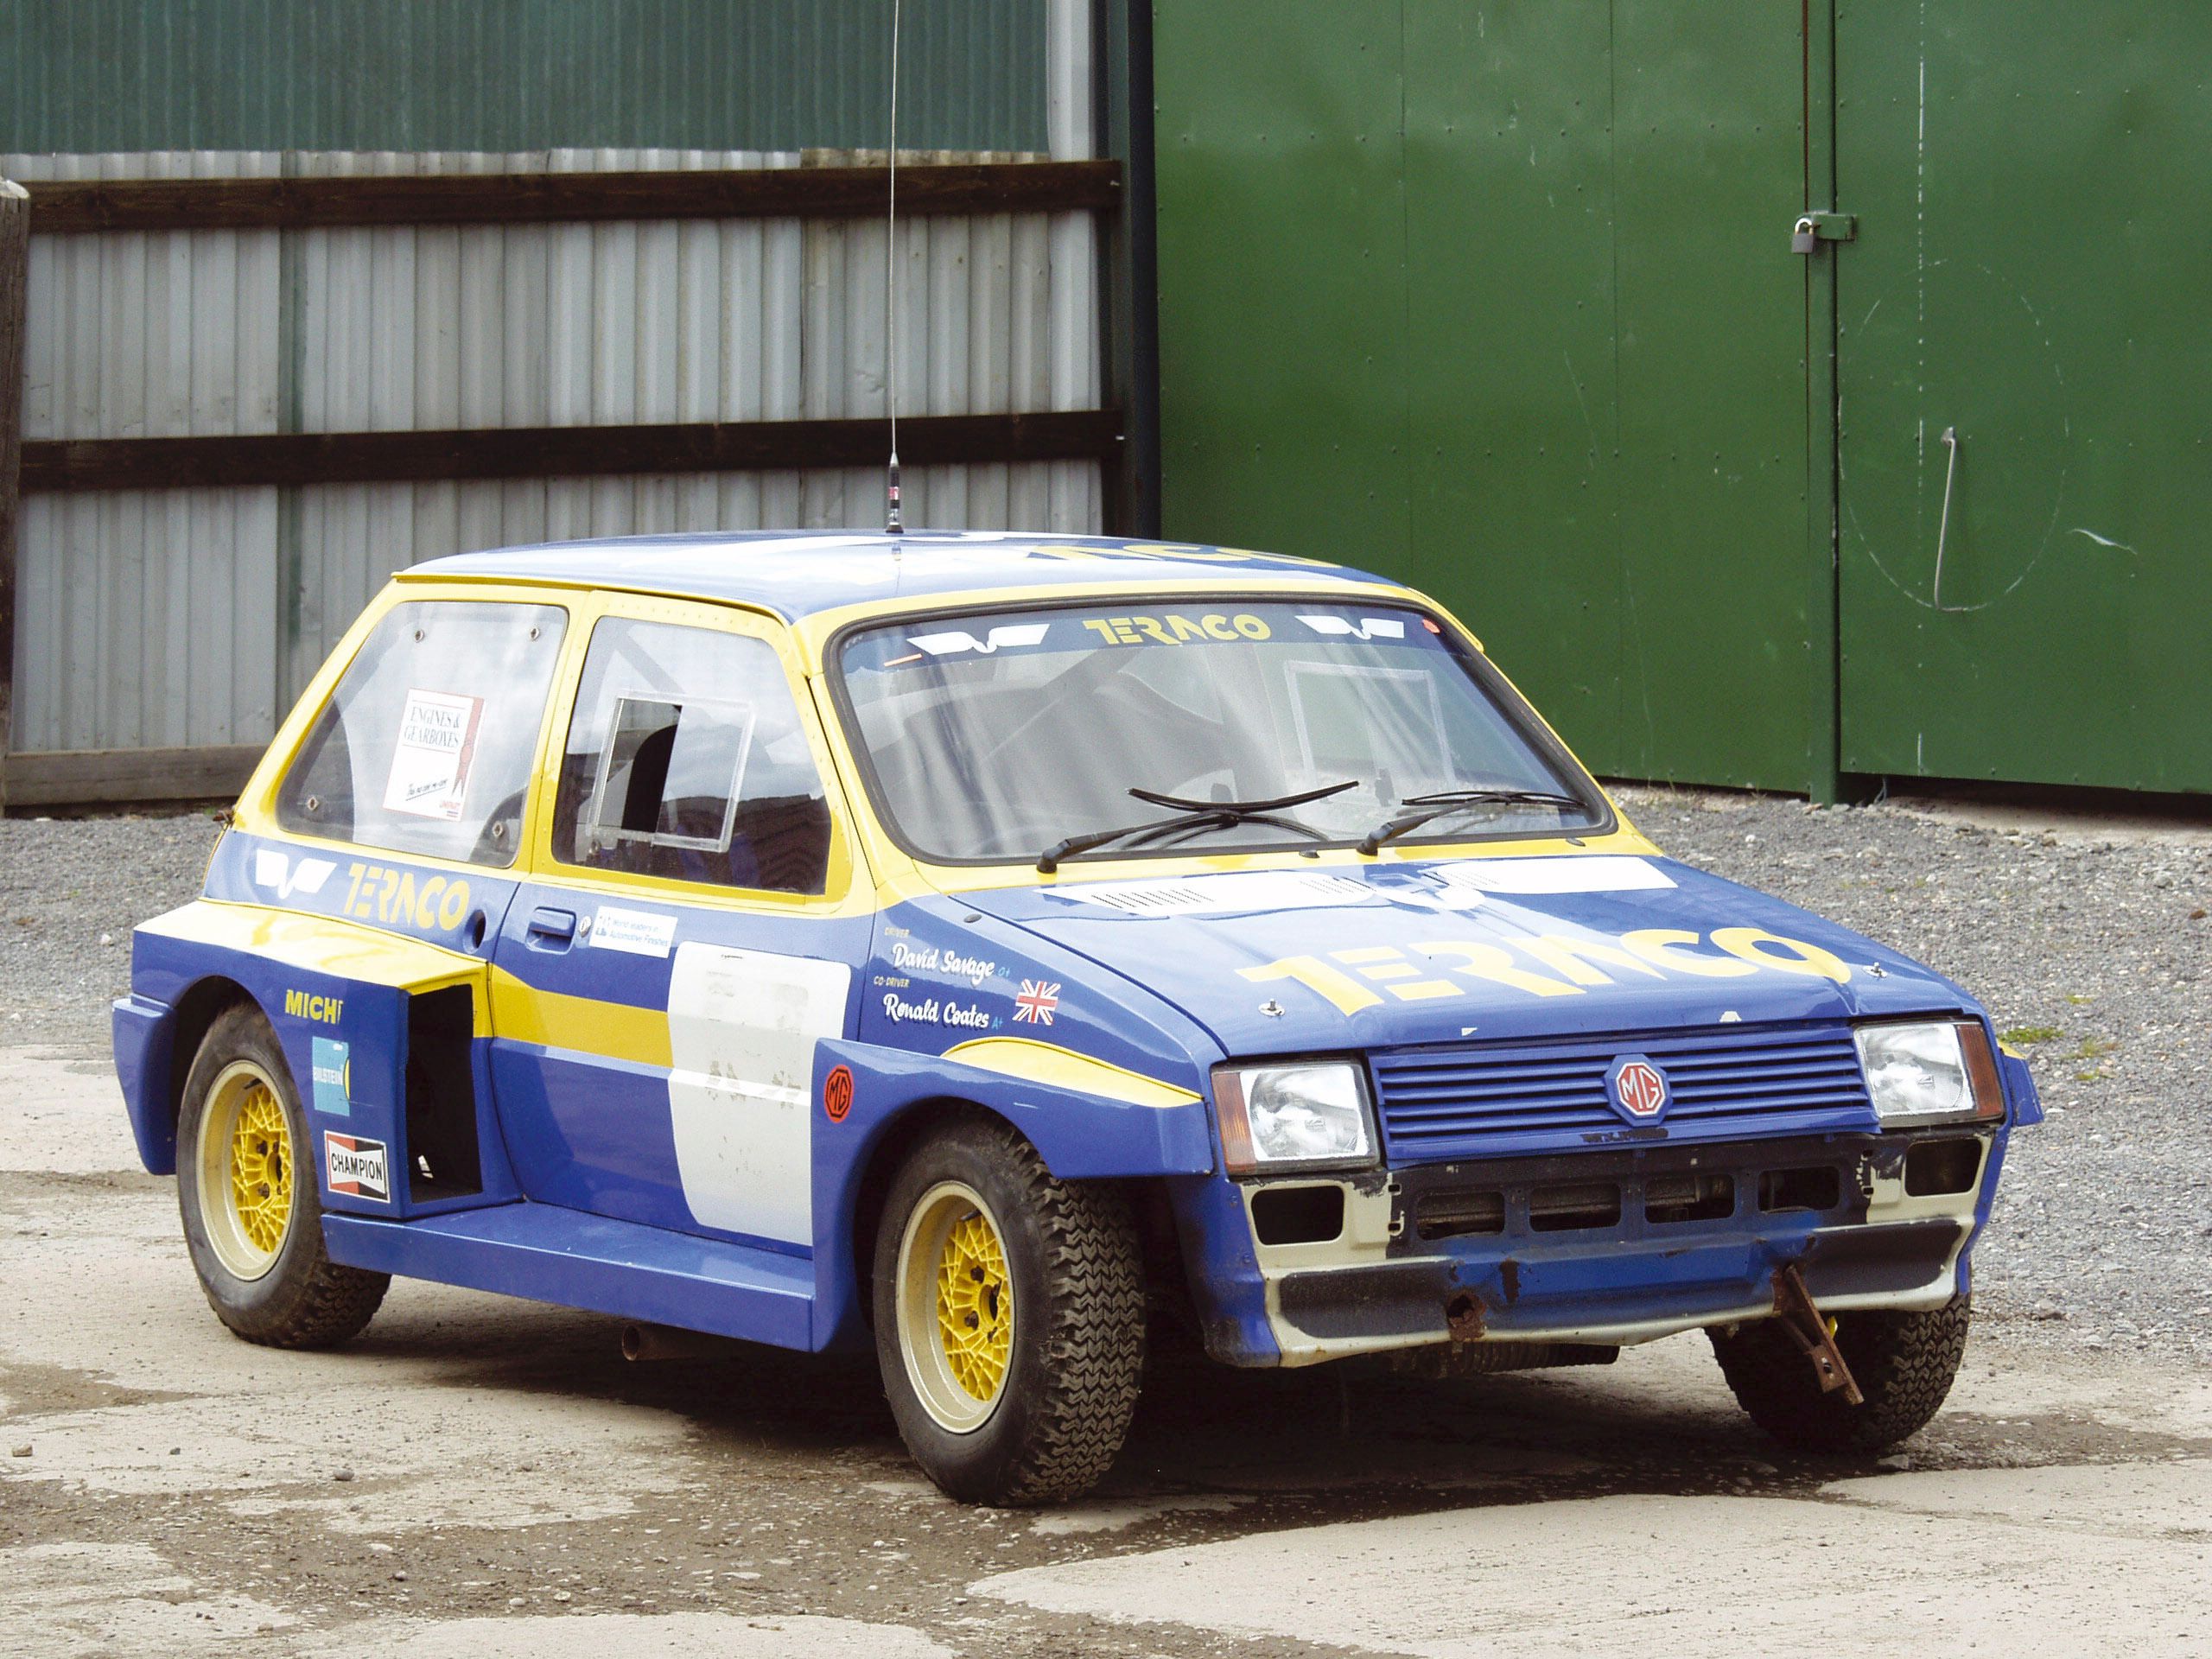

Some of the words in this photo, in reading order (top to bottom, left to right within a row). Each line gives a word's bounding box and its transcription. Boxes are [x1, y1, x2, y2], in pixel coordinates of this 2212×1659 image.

[1082, 613, 1272, 645] TERACO
[410, 706, 452, 728] ENGINES
[404, 725, 460, 748] GEARBOXES
[344, 861, 471, 931] TERACO
[884, 926, 911, 938] DRIVER
[874, 976, 911, 988] CO-DRIVER
[892, 943, 940, 970] David
[939, 950, 995, 987] Savage
[1235, 927, 1852, 1018] TERACO
[882, 993, 940, 1023] Ronald
[943, 1001, 990, 1030] Coates
[829, 1076, 849, 1112] MG
[1621, 1067, 1661, 1109] MG
[330, 1152, 383, 1181] CHAMPION
